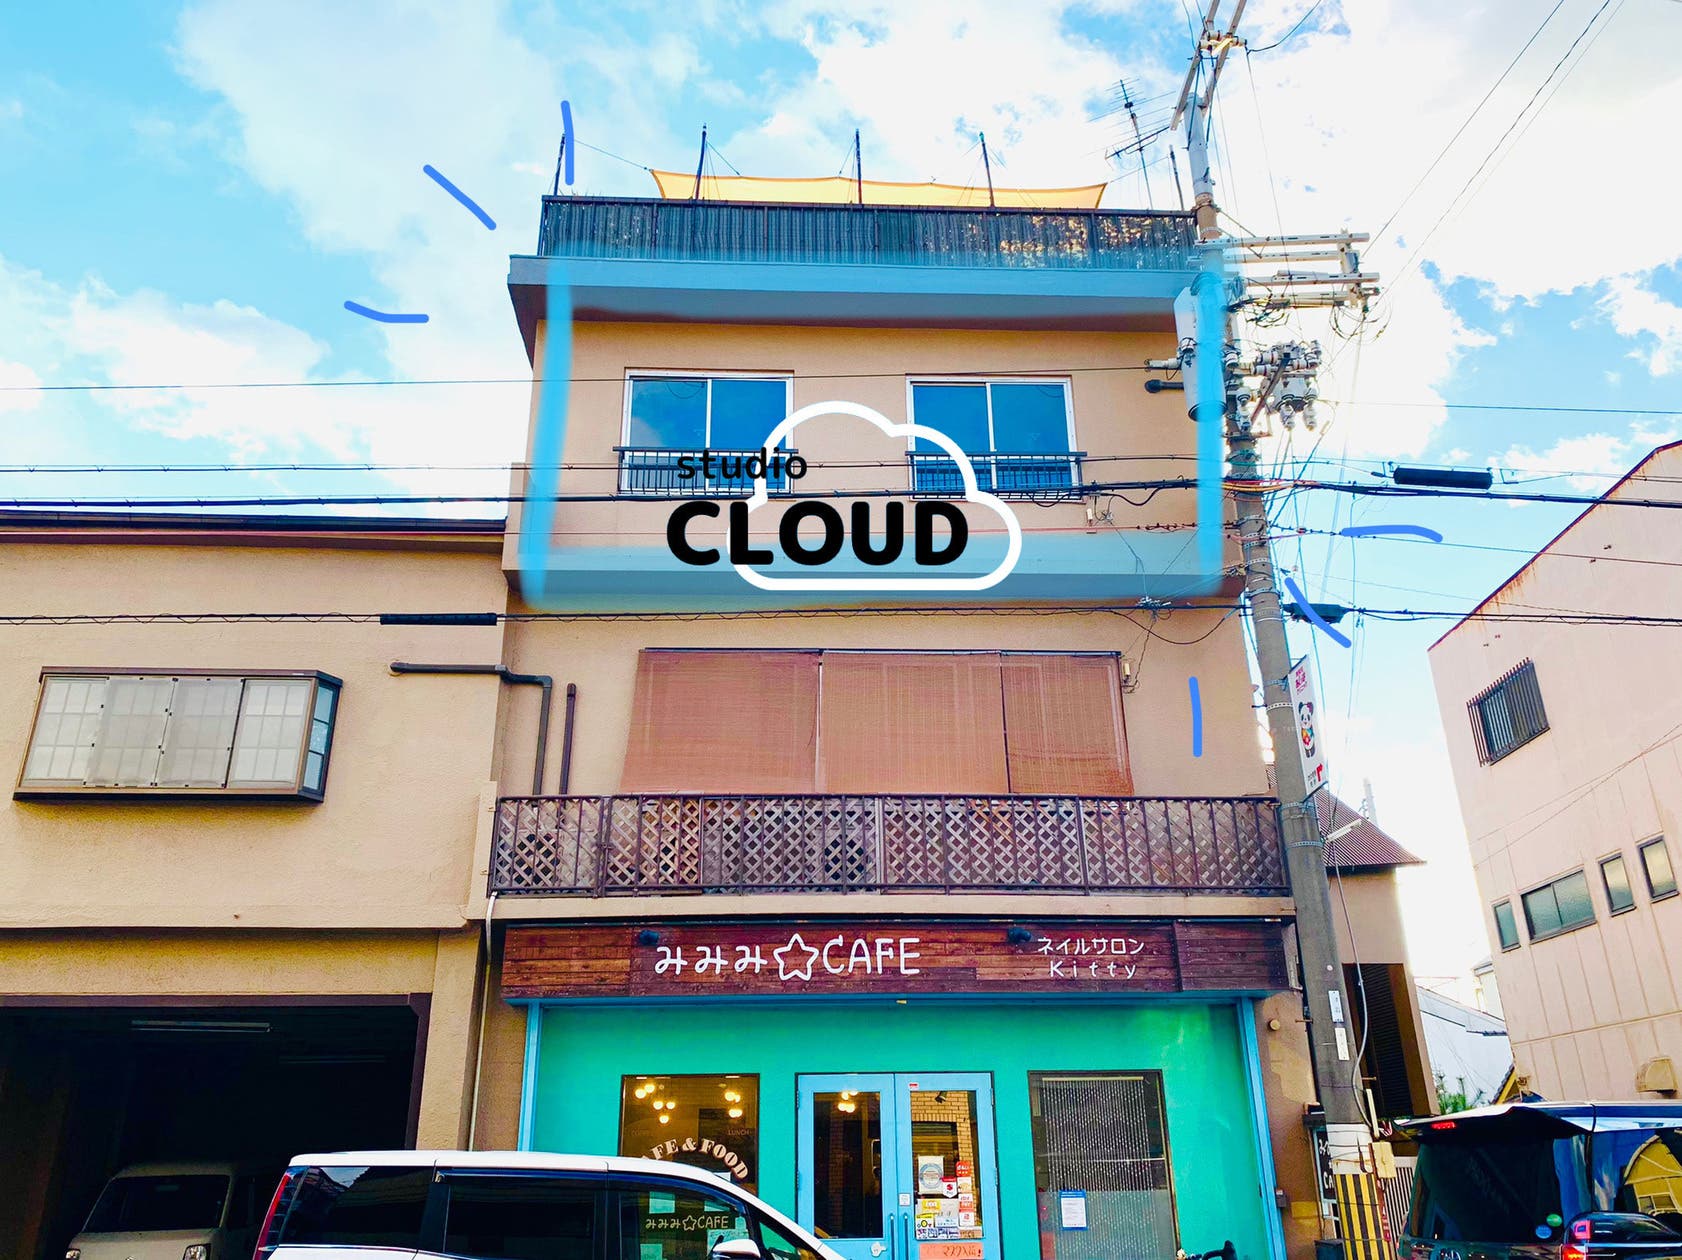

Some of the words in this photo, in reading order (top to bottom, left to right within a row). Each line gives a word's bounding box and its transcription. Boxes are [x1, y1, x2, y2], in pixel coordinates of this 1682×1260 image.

[654, 945, 768, 975] みみみ
[822, 934, 921, 975] CAFE
[1037, 936, 1145, 955] ネイルサロン
[1049, 960, 1136, 979] Kitty
[641, 1138, 679, 1161] FE
[681, 1137, 698, 1152] &
[699, 1138, 749, 1180] FOOD
[1323, 1171, 1335, 1190] CA
[697, 1215, 729, 1229] CAFE
